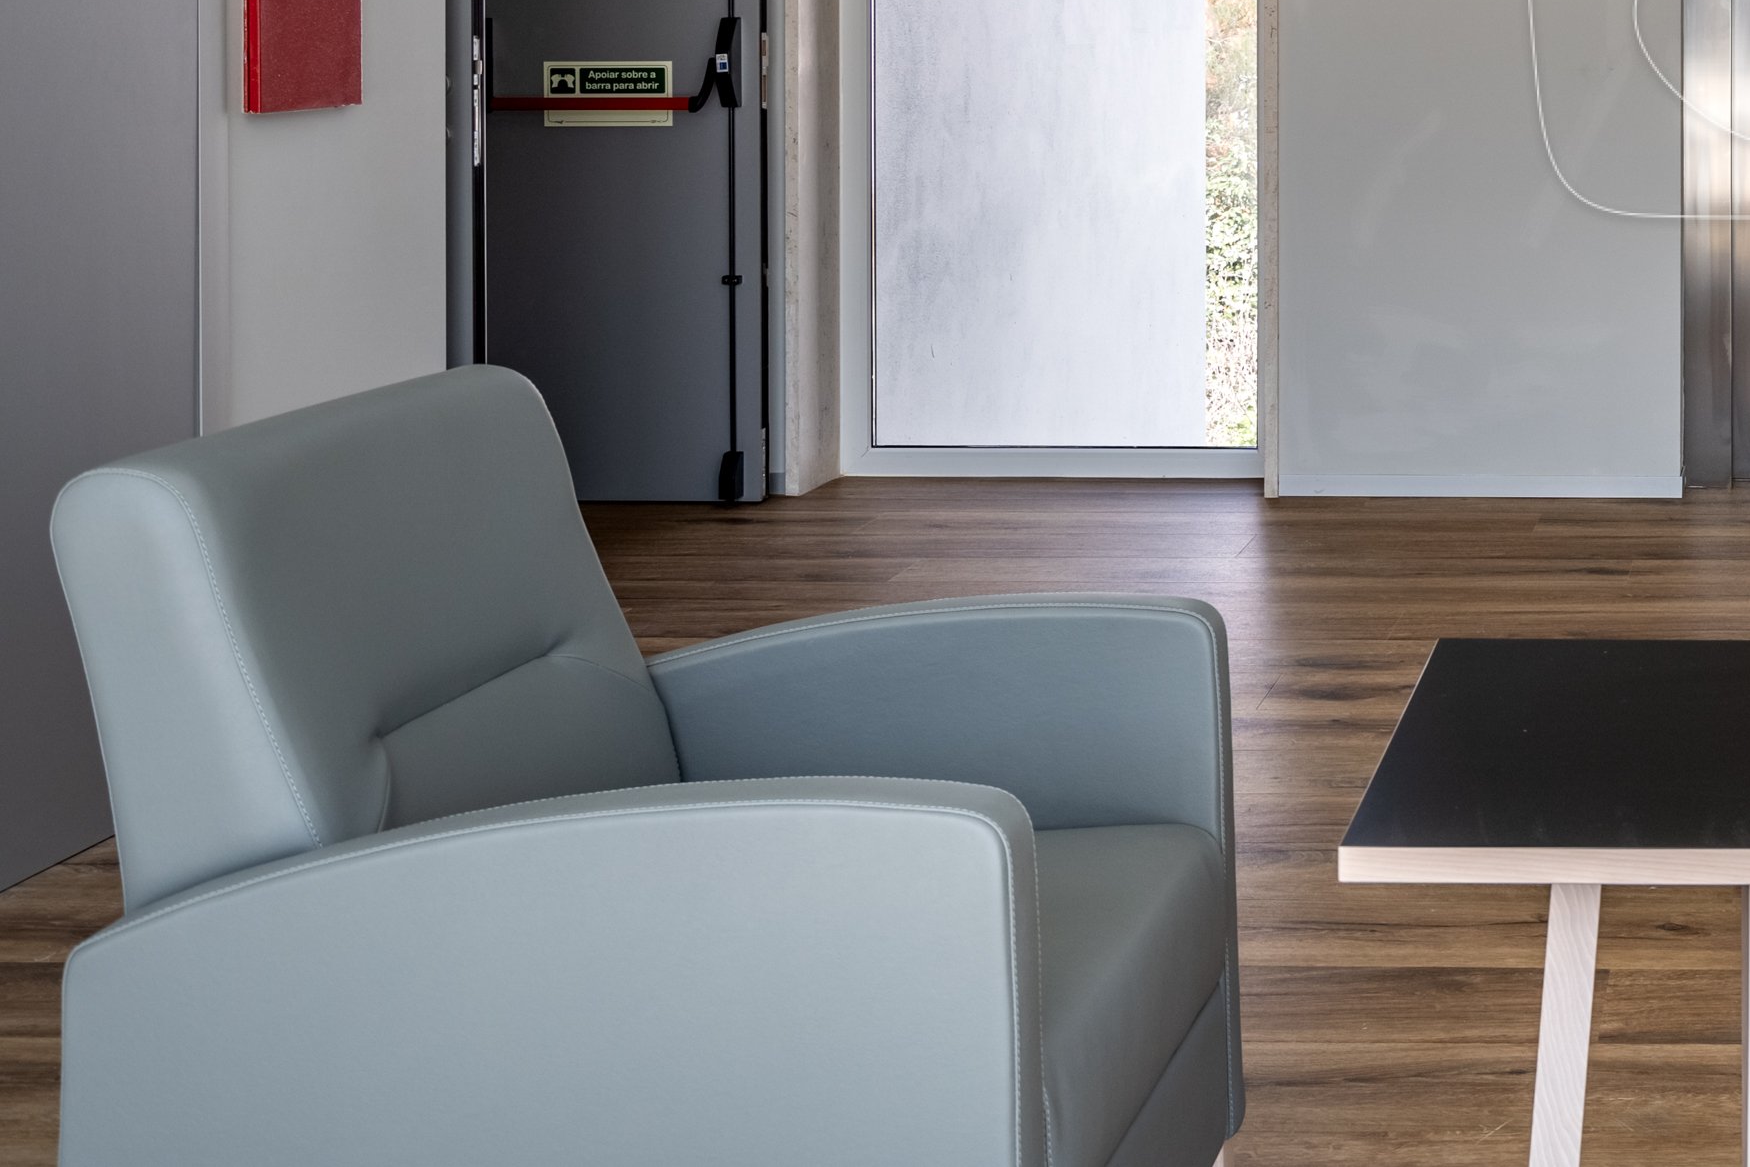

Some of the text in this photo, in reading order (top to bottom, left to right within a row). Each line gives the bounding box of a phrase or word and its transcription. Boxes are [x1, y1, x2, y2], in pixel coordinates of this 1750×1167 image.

[588, 70, 620, 80] Apoiar
[621, 70, 648, 79] sobre
[585, 81, 659, 91] barra para abrir
